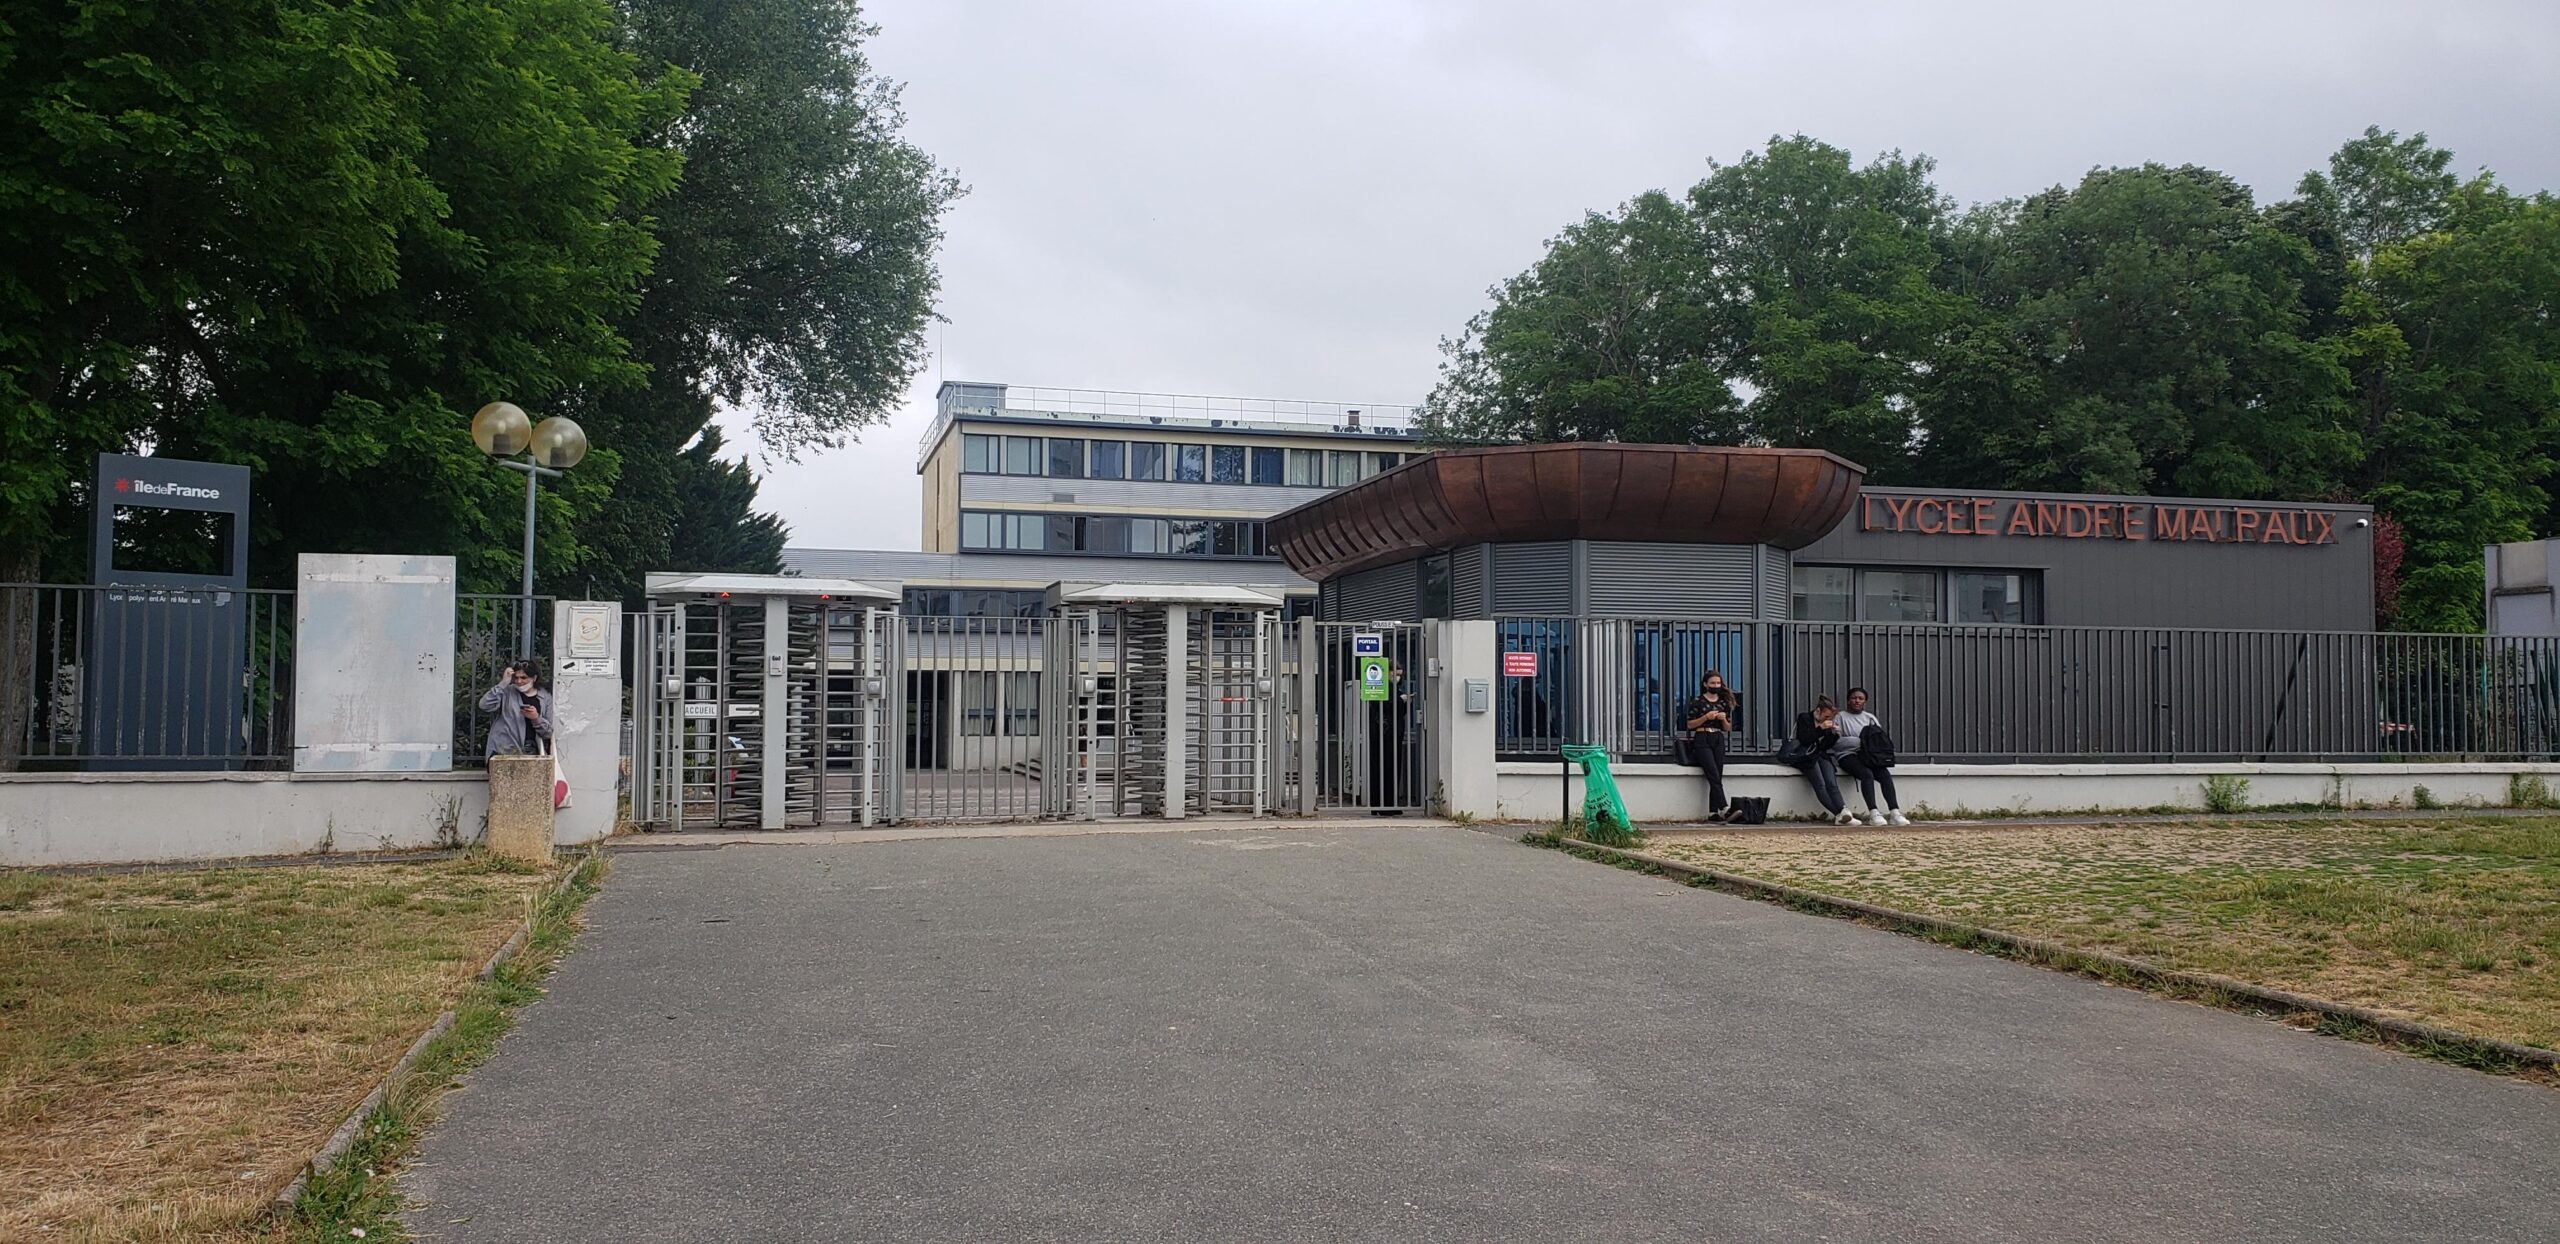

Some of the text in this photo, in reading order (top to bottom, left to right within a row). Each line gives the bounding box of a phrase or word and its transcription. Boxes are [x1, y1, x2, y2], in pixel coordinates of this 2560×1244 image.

[1863, 495, 2339, 545] LYCEE ANDRE MALRAUX
[685, 706, 715, 715] ACCUEIL
